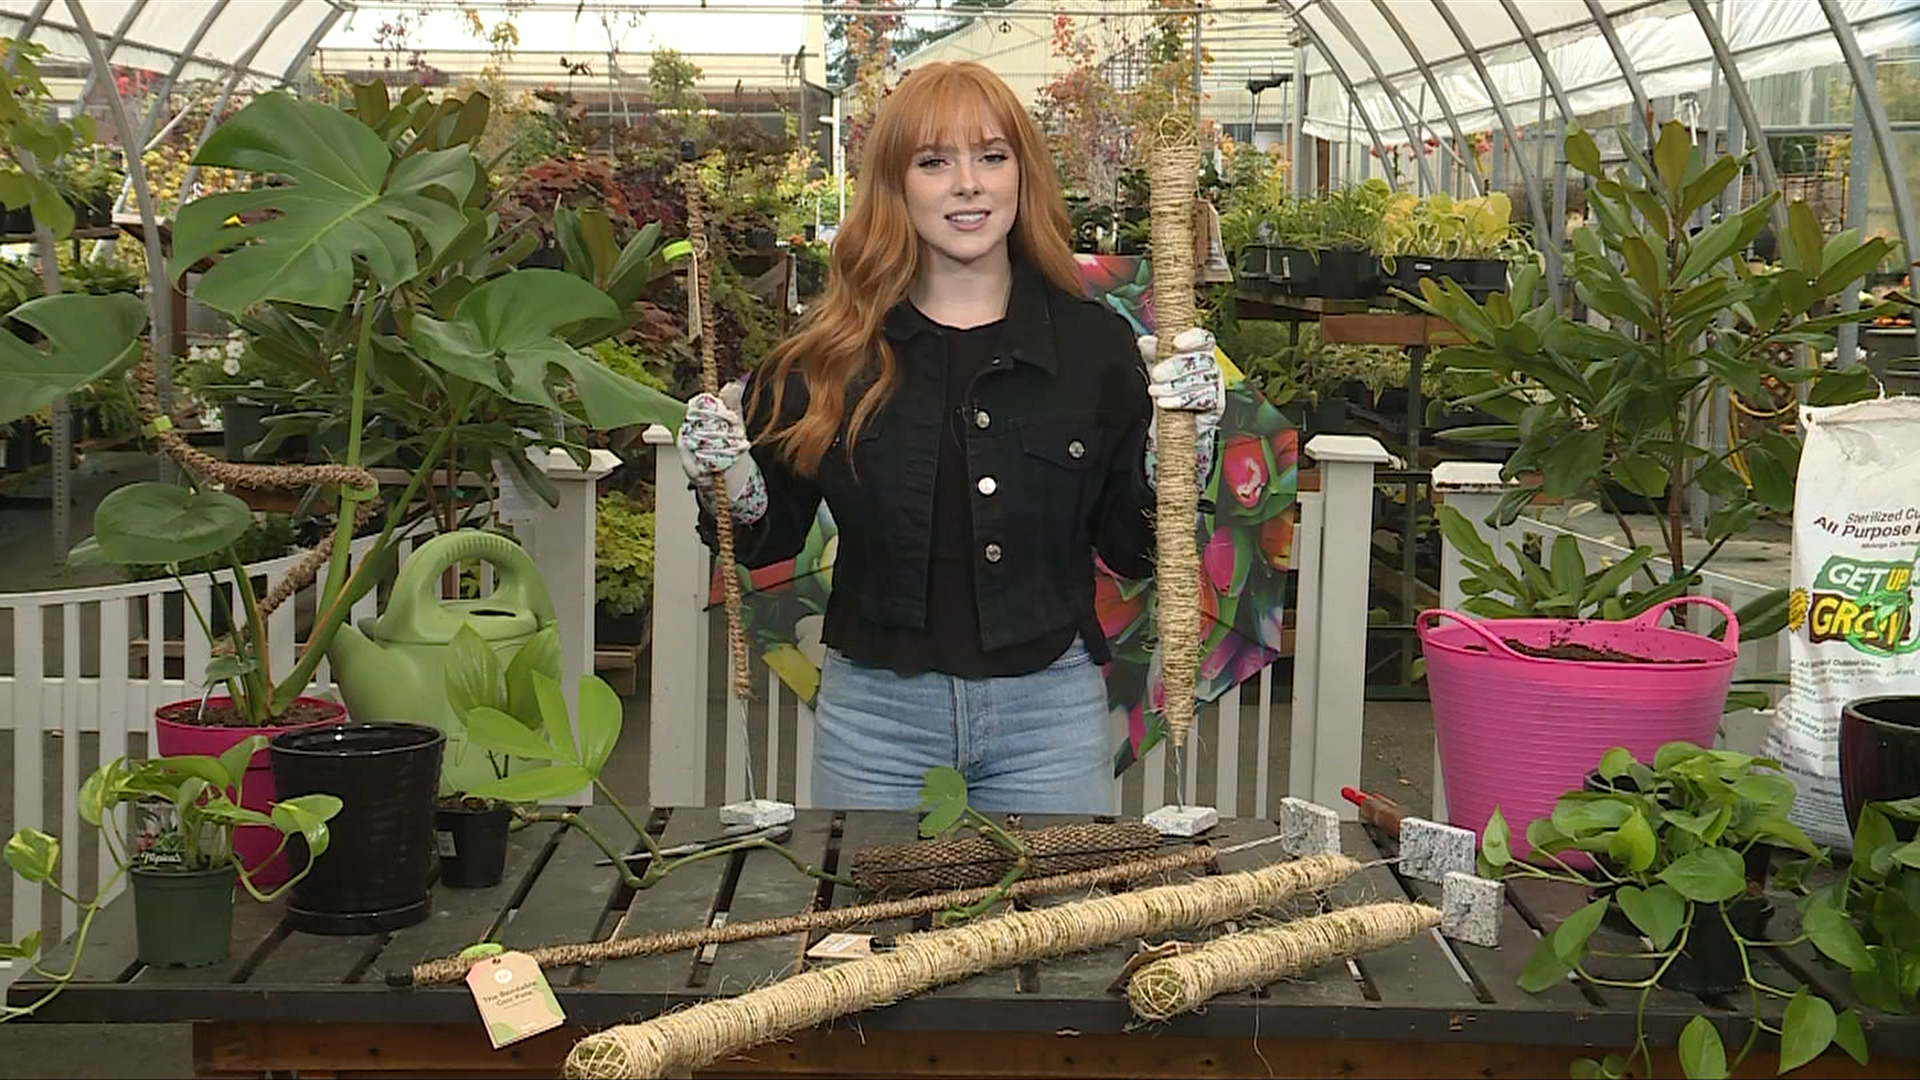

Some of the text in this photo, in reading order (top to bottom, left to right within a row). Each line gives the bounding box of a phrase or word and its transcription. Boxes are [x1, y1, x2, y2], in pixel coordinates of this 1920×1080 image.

[1845, 508, 1904, 524] Sterilized
[1812, 516, 1839, 534] All
[1841, 524, 1912, 542] Purpose
[1828, 562, 1911, 595] GET UP
[482, 994, 498, 1003] The
